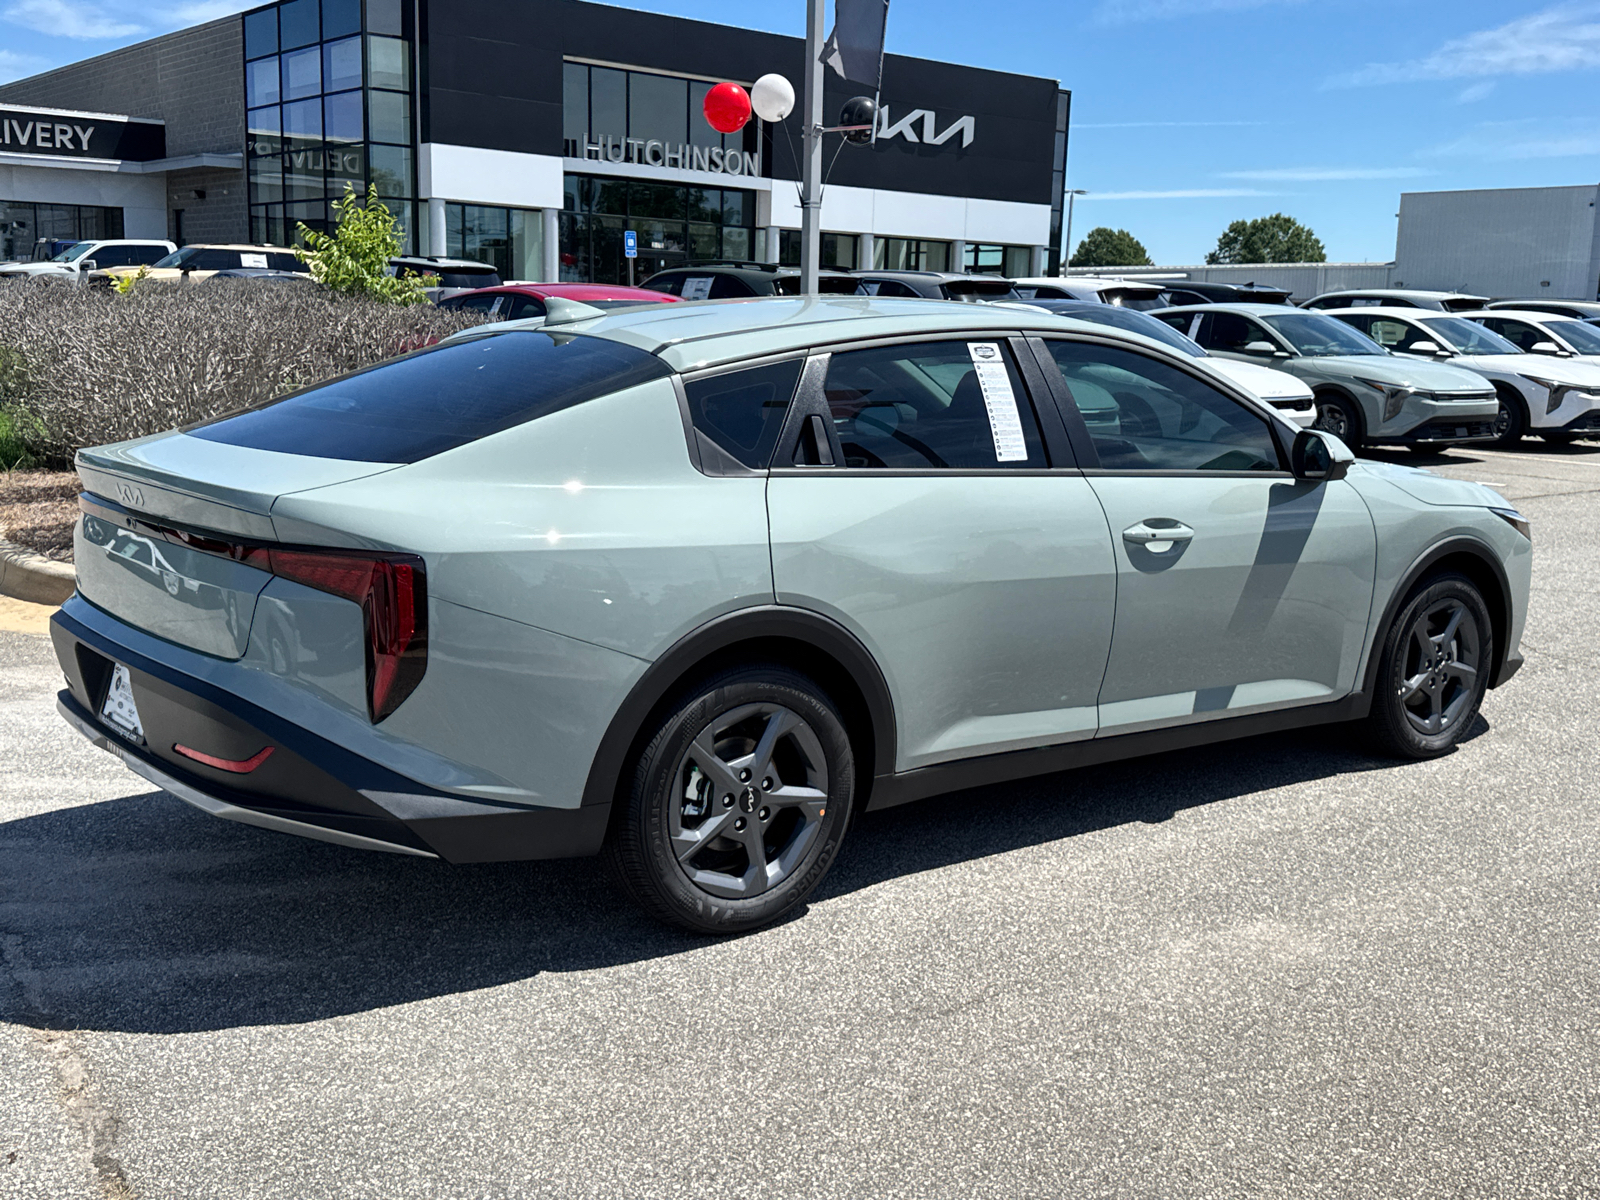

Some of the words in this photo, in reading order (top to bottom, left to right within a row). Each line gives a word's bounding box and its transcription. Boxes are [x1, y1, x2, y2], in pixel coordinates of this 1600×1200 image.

[0, 119, 95, 151] IVERY
[878, 104, 975, 149] KIA
[582, 133, 759, 177] HUTCHINSON
[115, 482, 145, 507] KIA
[786, 840, 836, 901] KUMHO
